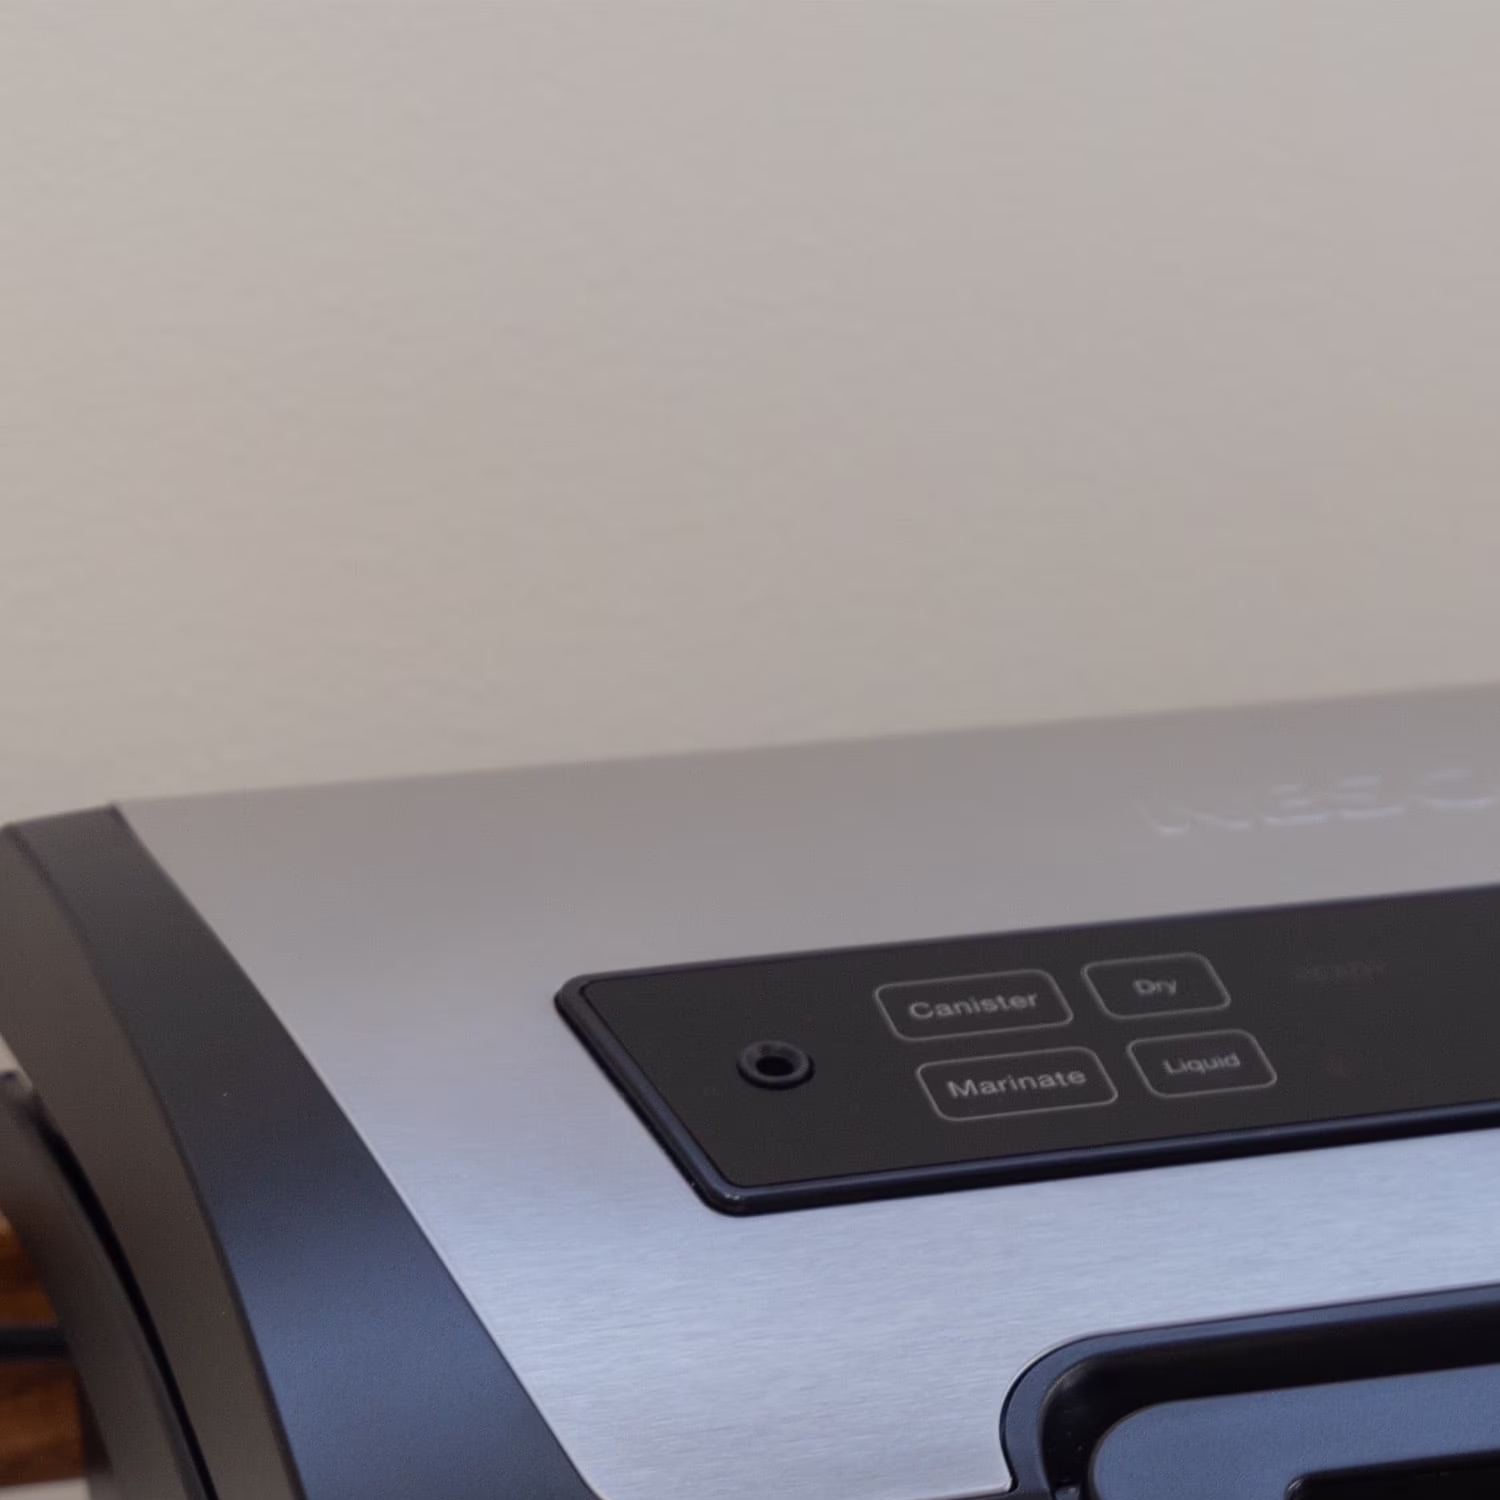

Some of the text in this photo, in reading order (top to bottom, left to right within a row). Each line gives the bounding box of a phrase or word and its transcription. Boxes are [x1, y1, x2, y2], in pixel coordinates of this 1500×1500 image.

[1132, 978, 1178, 998] Dry
[908, 990, 1039, 1021] Canister
[1162, 1051, 1242, 1077] Liquid
[946, 1068, 1087, 1100] Marinate
